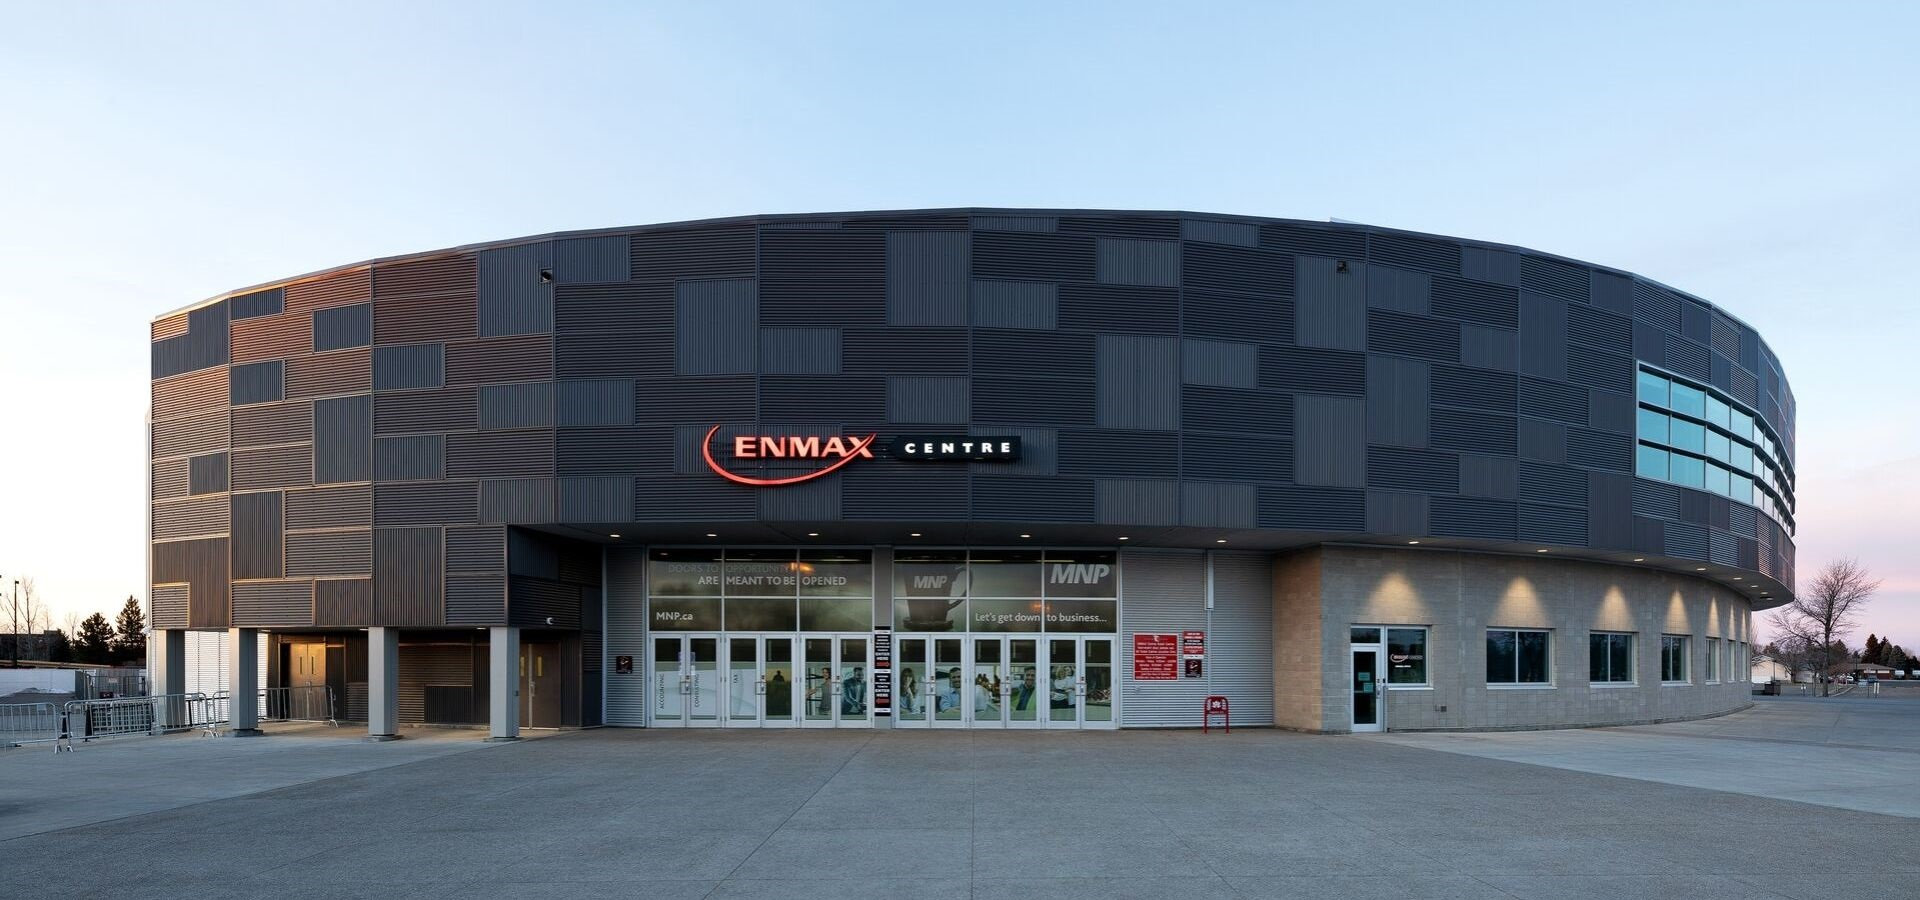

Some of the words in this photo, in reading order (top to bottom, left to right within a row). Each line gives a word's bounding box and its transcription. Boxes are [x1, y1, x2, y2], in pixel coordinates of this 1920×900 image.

[735, 434, 876, 459] ENMAX
[904, 442, 1011, 454] CENTRE
[1050, 563, 1110, 585] MNP
[698, 576, 719, 586] ARE
[726, 576, 763, 586] MEANT
[766, 576, 782, 586] TO
[783, 576, 796, 586] BE
[802, 576, 847, 586] OPENED
[913, 575, 948, 589] MNP
[656, 611, 694, 621] MNP.ca
[975, 613, 997, 622] Let's
[998, 613, 1013, 624] get
[1014, 613, 1041, 622] down
[1047, 613, 1058, 622] to
[1059, 613, 1108, 622] business...
